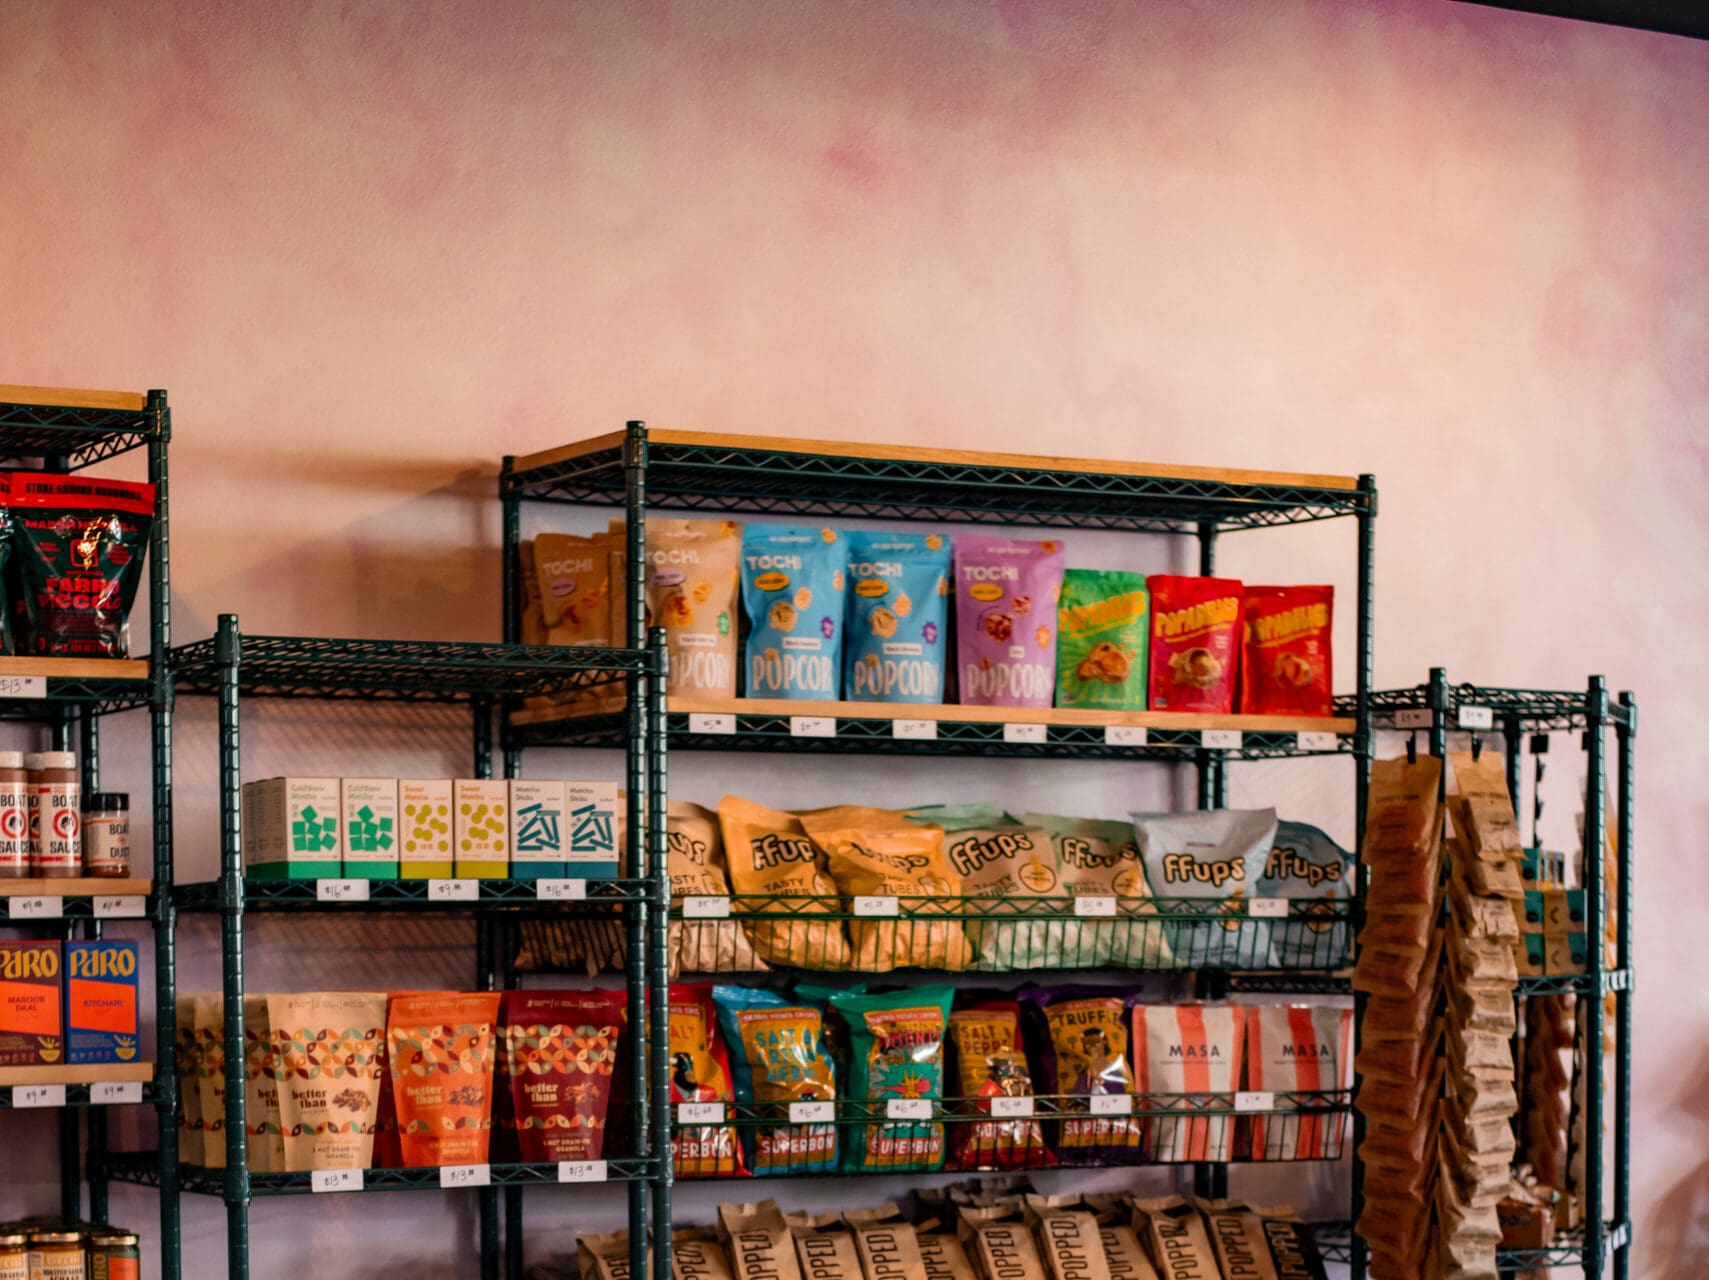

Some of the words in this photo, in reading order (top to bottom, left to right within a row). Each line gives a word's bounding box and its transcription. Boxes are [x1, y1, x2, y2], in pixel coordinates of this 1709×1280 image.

[543, 558, 594, 576] TOCHI
[747, 555, 802, 571] TOCHI
[848, 562, 903, 577] TOCHI
[962, 565, 1019, 581] TOCHI
[670, 873, 697, 885] ASTY
[763, 877, 804, 893] TASTY
[671, 885, 702, 895] UBES
[881, 883, 920, 895] TUBES
[671, 1025, 695, 1041] ALT
[960, 1025, 995, 1041] SALT
[1169, 1044, 1221, 1058] MASA
[1282, 1044, 1330, 1057] MASA
[292, 1089, 328, 1101] better
[407, 1083, 443, 1096] better
[524, 1083, 559, 1095] better
[300, 1098, 328, 1109] than
[415, 1094, 443, 1105] than
[531, 1092, 558, 1103] than
[671, 1142, 732, 1158] PERBON
[761, 1136, 834, 1154] SUPERBON
[872, 1139, 940, 1155] SUPERBON
